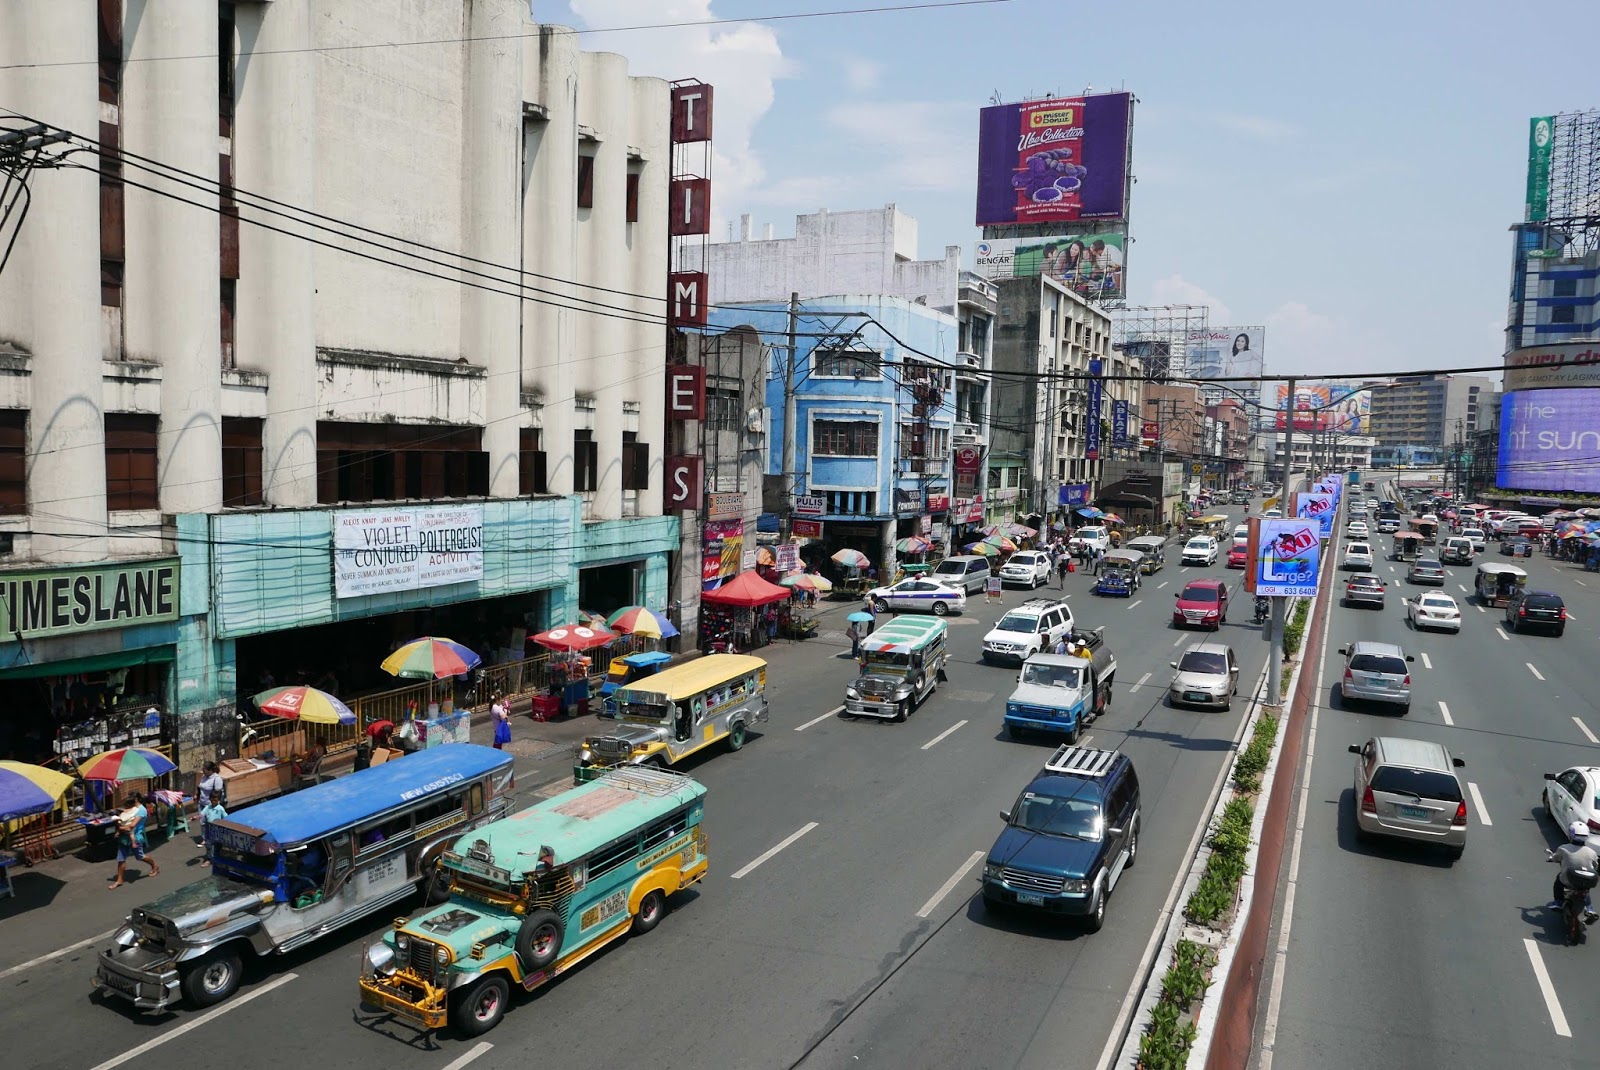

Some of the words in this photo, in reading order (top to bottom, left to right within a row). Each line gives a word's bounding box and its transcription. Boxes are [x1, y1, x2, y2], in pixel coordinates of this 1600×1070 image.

[1041, 127, 1085, 143] Collection
[1523, 402, 1556, 419] the
[716, 495, 742, 505] BOULEVARD
[796, 498, 823, 507] PULIS
[343, 518, 360, 526] ALEXIS
[363, 525, 411, 547] VIOLET
[419, 526, 482, 554] POLTERGEIST
[355, 543, 418, 568] CONJURED
[429, 551, 470, 566] ACTIVITY
[1263, 547, 1313, 585] Large?
[341, 573, 356, 581] NEVER
[351, 583, 370, 591] DIRECTED
[1284, 587, 1297, 595] 633
[1299, 587, 1316, 596] 6408
[0, 567, 174, 633] IMESLANE
[400, 787, 424, 801] NEW
